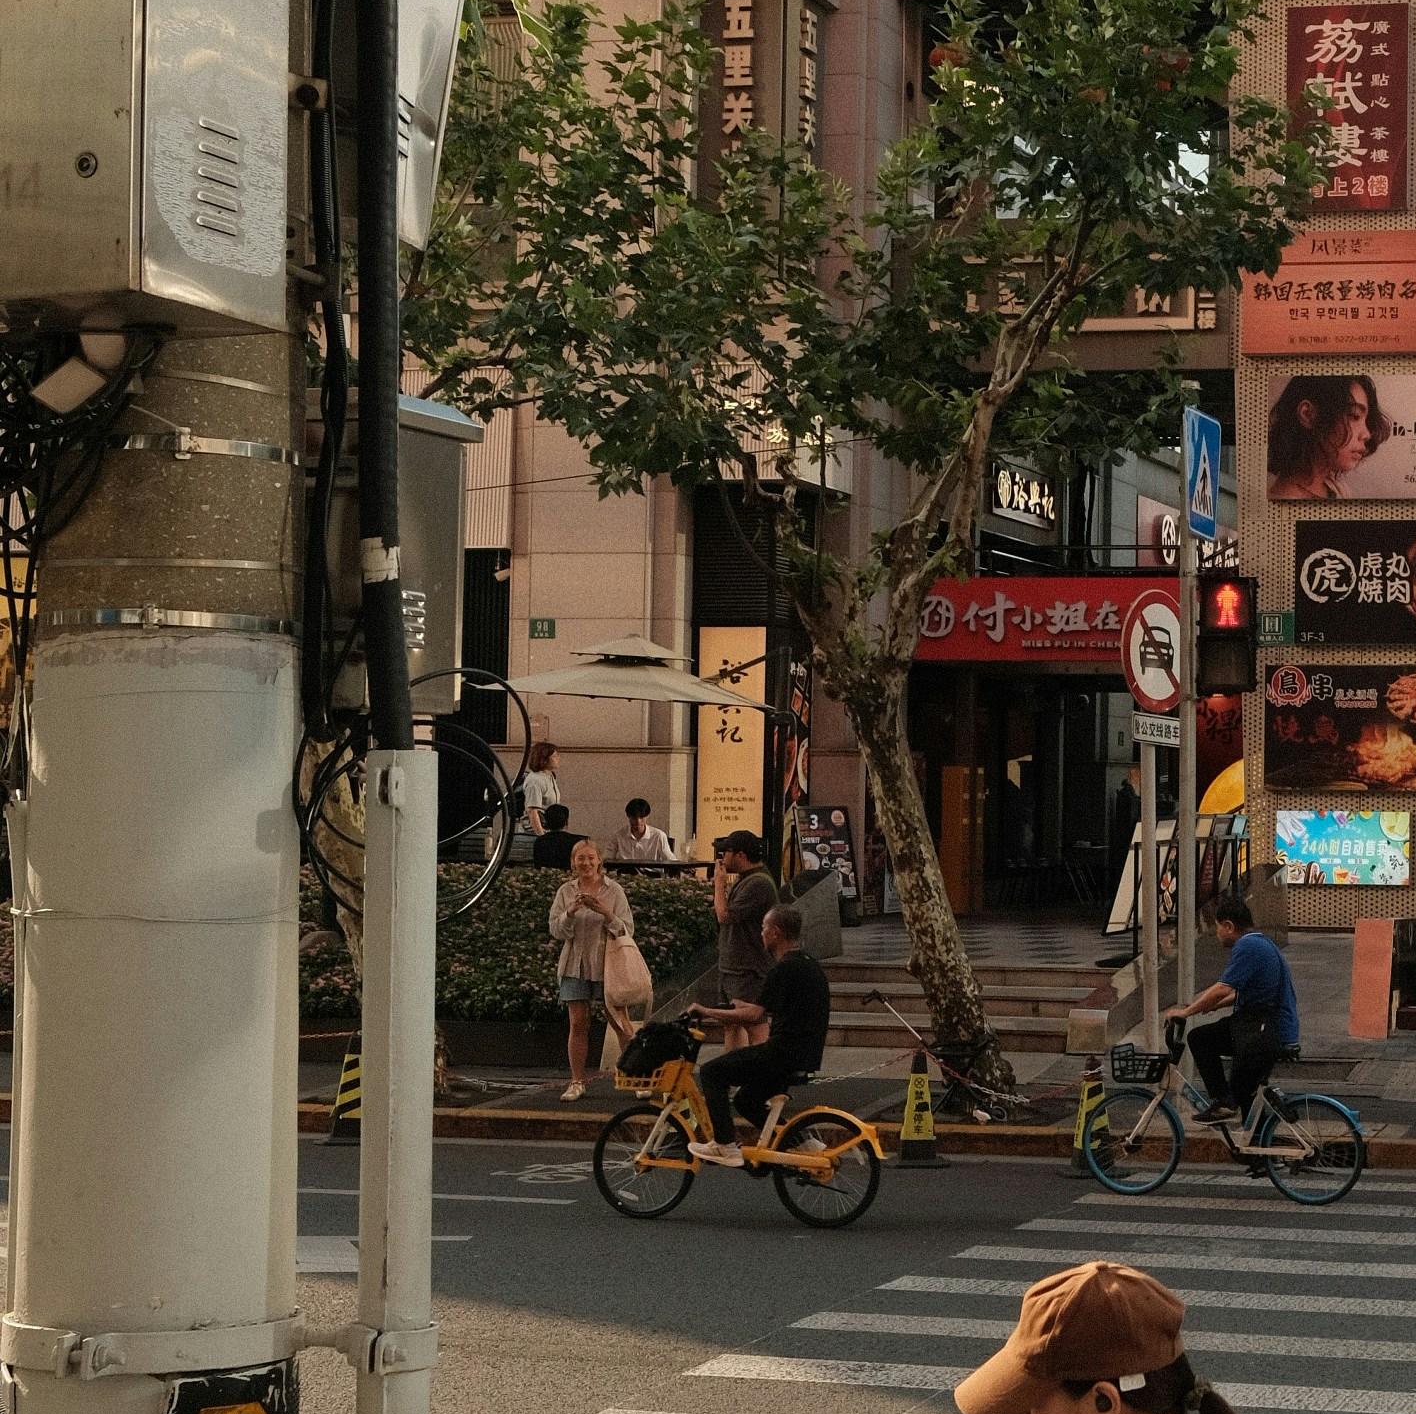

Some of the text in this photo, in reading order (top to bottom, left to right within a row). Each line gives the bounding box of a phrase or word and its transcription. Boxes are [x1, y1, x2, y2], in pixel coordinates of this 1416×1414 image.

[1358, 551, 1412, 578] 虎丸
[961, 590, 1122, 643] 付小姐在
[536, 621, 549, 632] 98
[1089, 639, 1122, 649] CHEN
[1299, 632, 1325, 642] 3F-3
[1300, 838, 1390, 857] 24小时自动售卖
[912, 1088, 926, 1137] 禁停车
